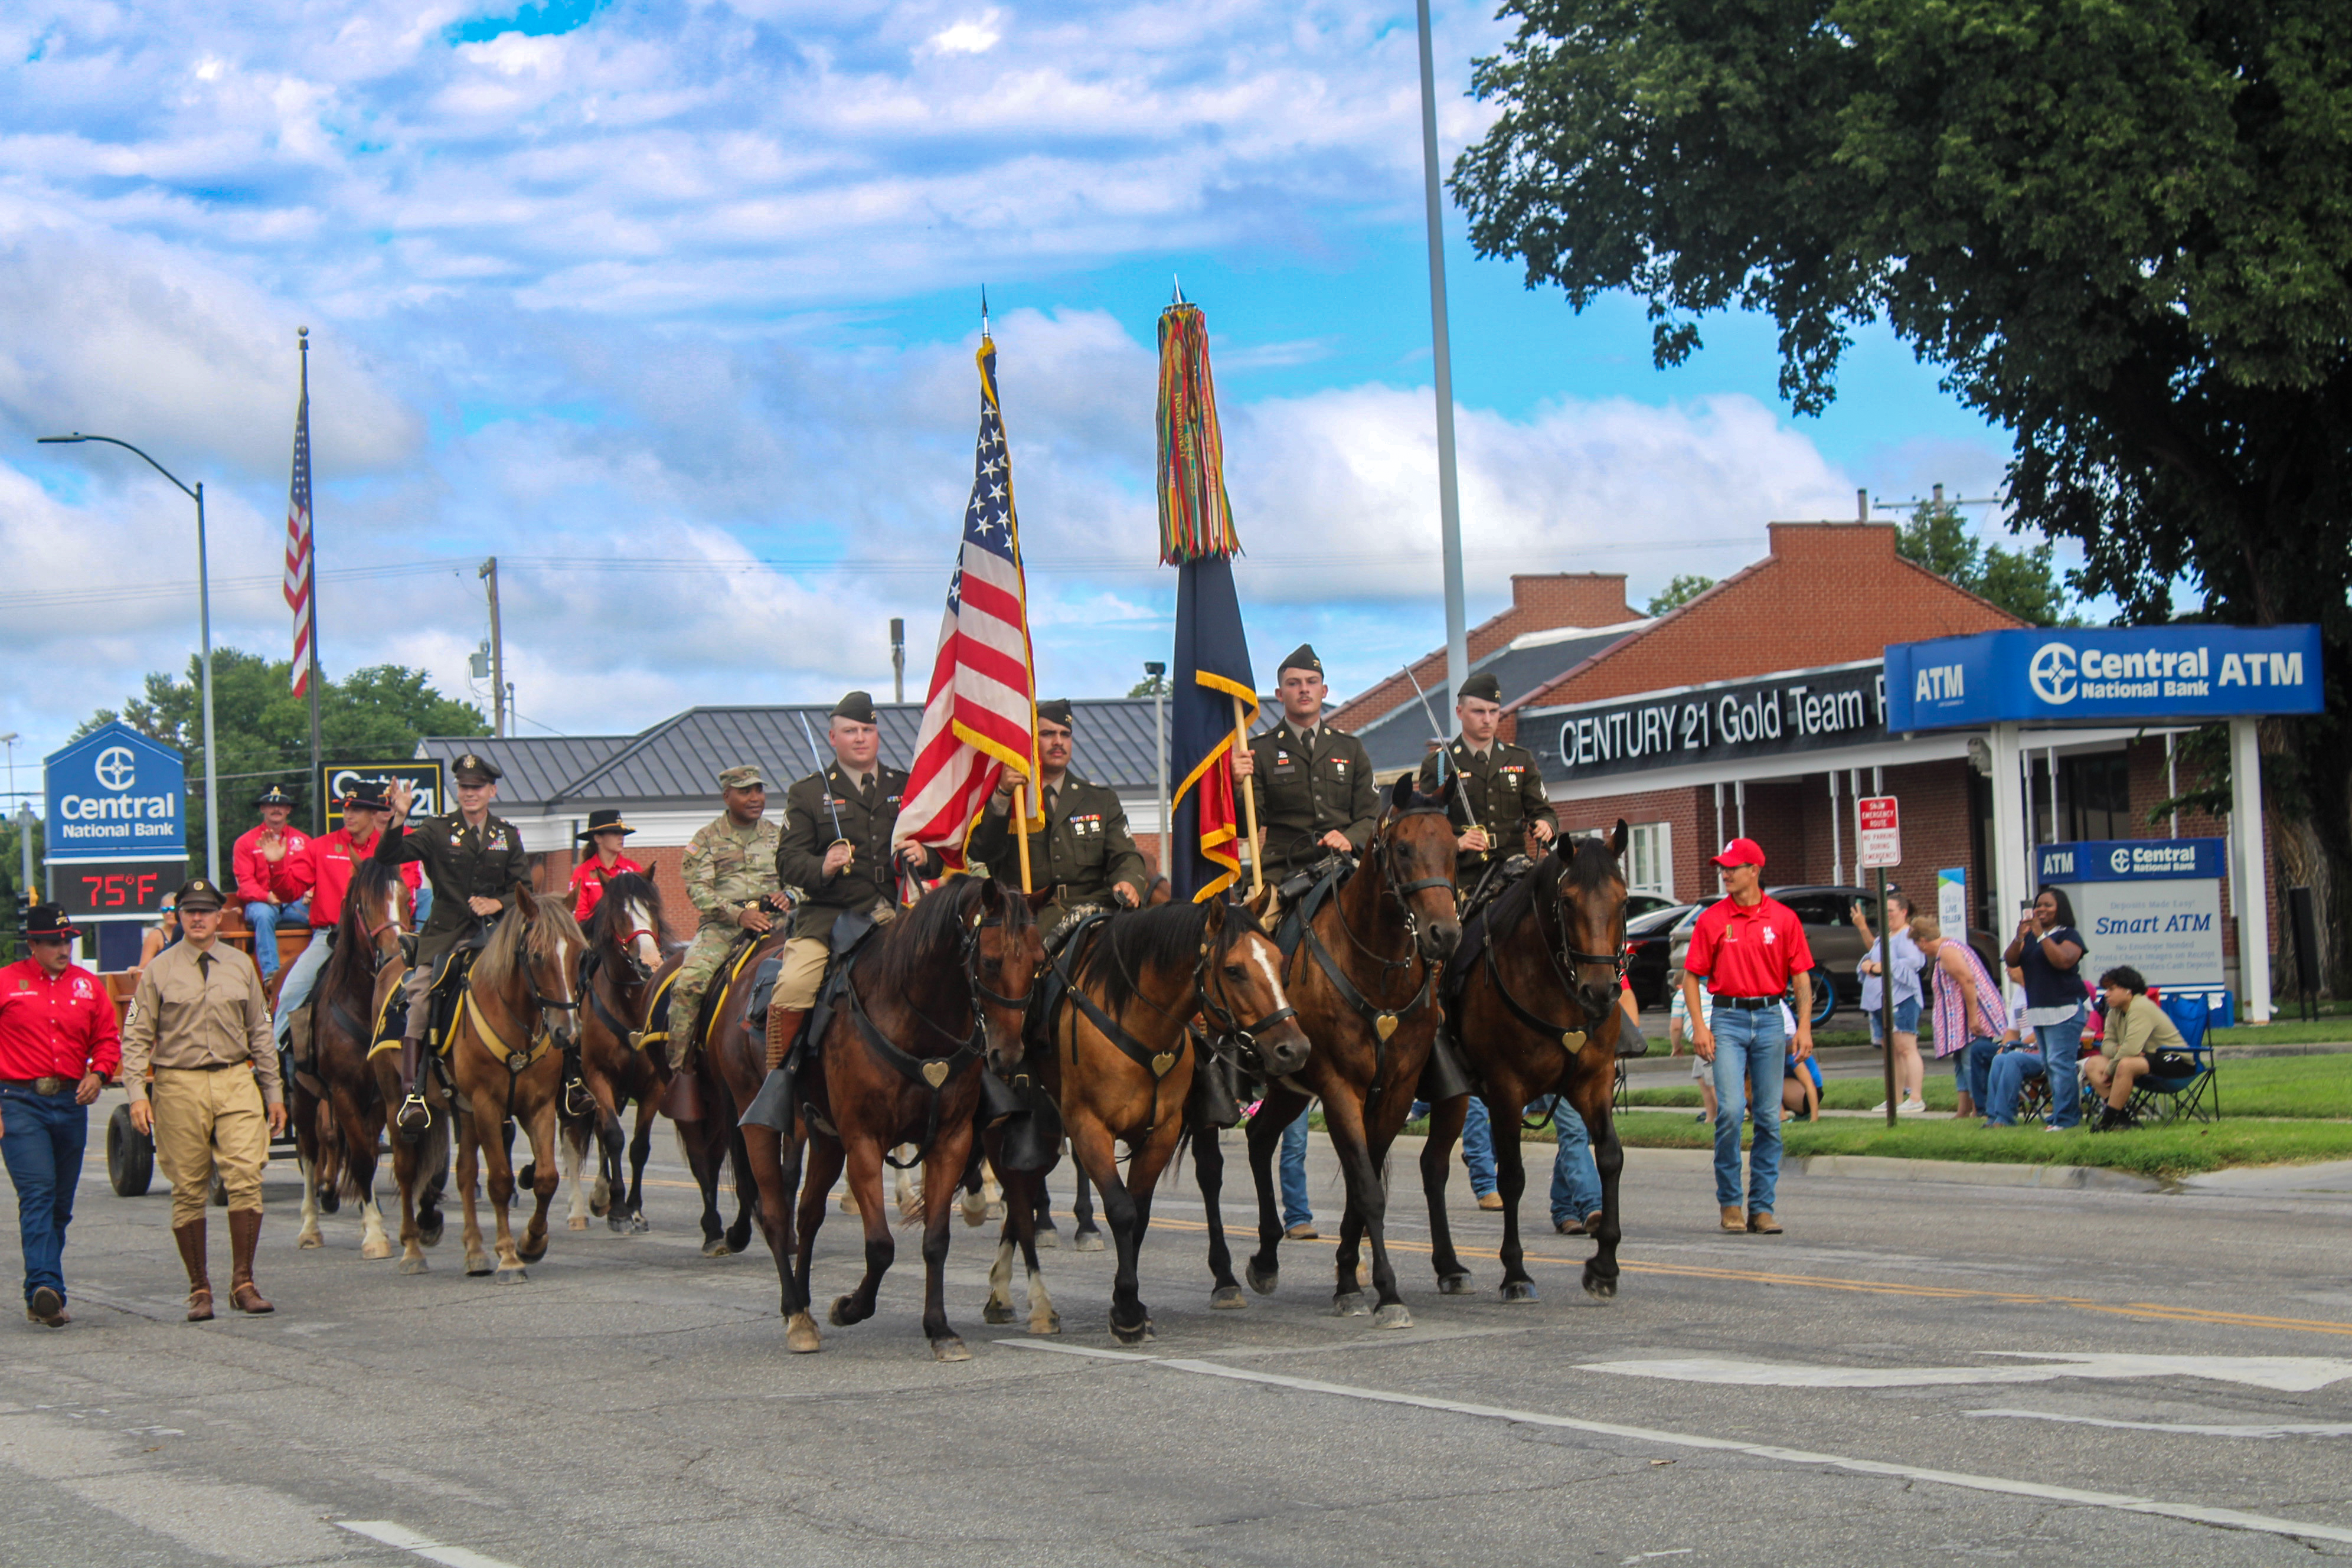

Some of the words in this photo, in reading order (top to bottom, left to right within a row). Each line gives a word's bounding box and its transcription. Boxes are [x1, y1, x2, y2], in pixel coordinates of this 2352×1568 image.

[2080, 647, 2209, 679] Central
[2218, 652, 2304, 687] ATM
[1915, 664, 1964, 703] ATM
[2082, 680, 2159, 699] National
[2164, 679, 2209, 698] Bank
[1559, 705, 1677, 767] CENTURY
[1684, 701, 1710, 750] 21
[1719, 688, 1783, 745] Gold
[1788, 685, 1864, 736] Team
[60, 792, 175, 820] Central
[410, 788, 435, 816] 21
[1861, 809, 1894, 819] EMERGENCY
[1870, 819, 1887, 827] ROUTE
[63, 823, 130, 838] National
[135, 822, 175, 837] Bank
[1865, 851, 1896, 860] EMERGENCY
[2043, 852, 2074, 875] ATM
[2132, 845, 2196, 863] Central
[2133, 863, 2171, 873] National
[2173, 862, 2196, 871] Bank
[81, 873, 158, 907] 75°F
[2111, 901, 2146, 911] Deposits
[2095, 916, 2160, 935] Smart
[2164, 913, 2212, 932] ATM
[2129, 943, 2164, 952] Envelope
[2146, 953, 2173, 961] Images
[2188, 951, 2214, 959] Receipt
[2187, 961, 2217, 970] Deposits
